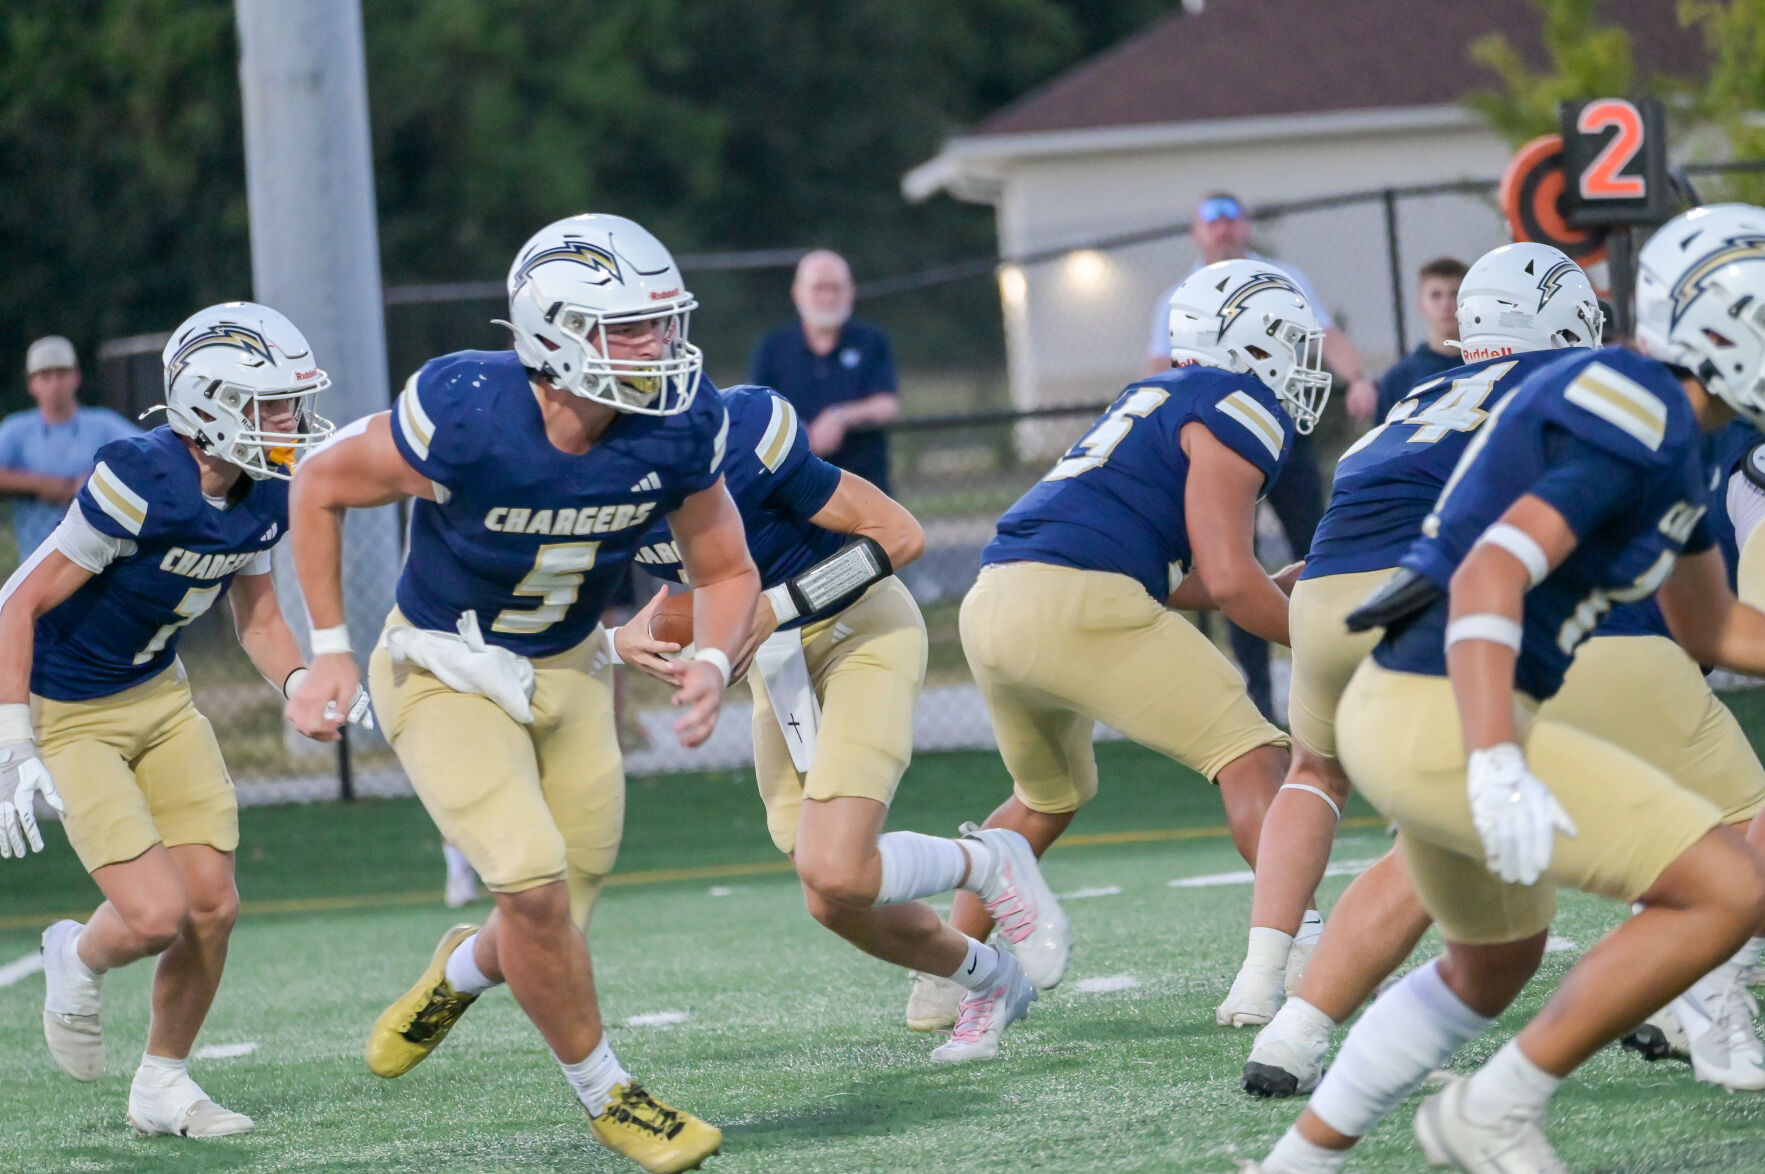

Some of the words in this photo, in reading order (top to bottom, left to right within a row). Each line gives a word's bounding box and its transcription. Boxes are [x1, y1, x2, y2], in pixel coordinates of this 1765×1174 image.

[1577, 98, 1645, 199] 2
[1463, 347, 1512, 361] Riddell
[484, 502, 657, 535] CHARGERS
[491, 541, 602, 633] 5
